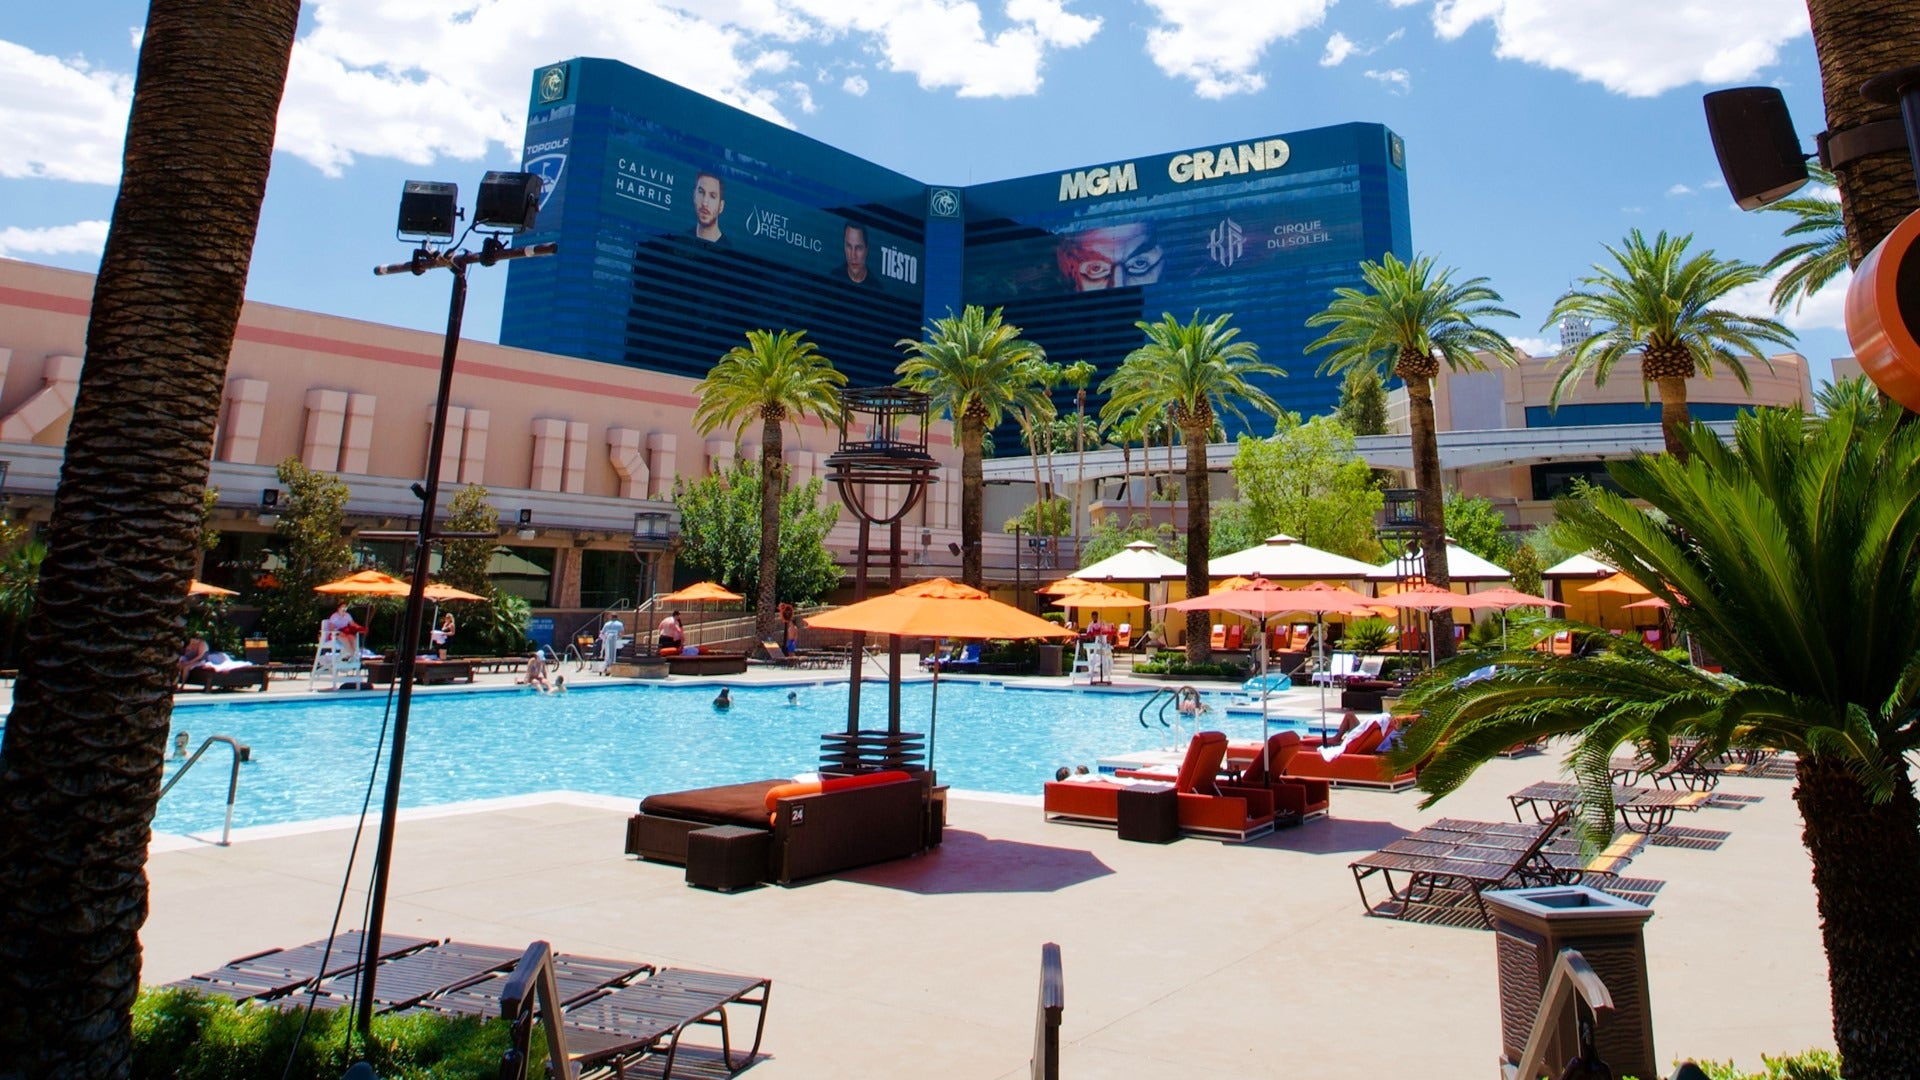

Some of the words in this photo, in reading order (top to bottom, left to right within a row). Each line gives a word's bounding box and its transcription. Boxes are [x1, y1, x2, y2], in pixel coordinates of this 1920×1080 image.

[526, 137, 569, 155] TOPGOLF
[618, 158, 674, 186] CALVIN
[1059, 163, 1138, 202] MGM
[1168, 138, 1290, 184] GRAND
[615, 178, 672, 205] HARRIS
[761, 209, 789, 229] WET
[1273, 220, 1322, 236] CIRQUE
[760, 222, 822, 253] REPUBLIC
[1267, 238, 1285, 249] DU
[1286, 232, 1333, 247] SOLEIL
[880, 246, 918, 285] TIËSTO
[791, 810, 803, 821] 24
